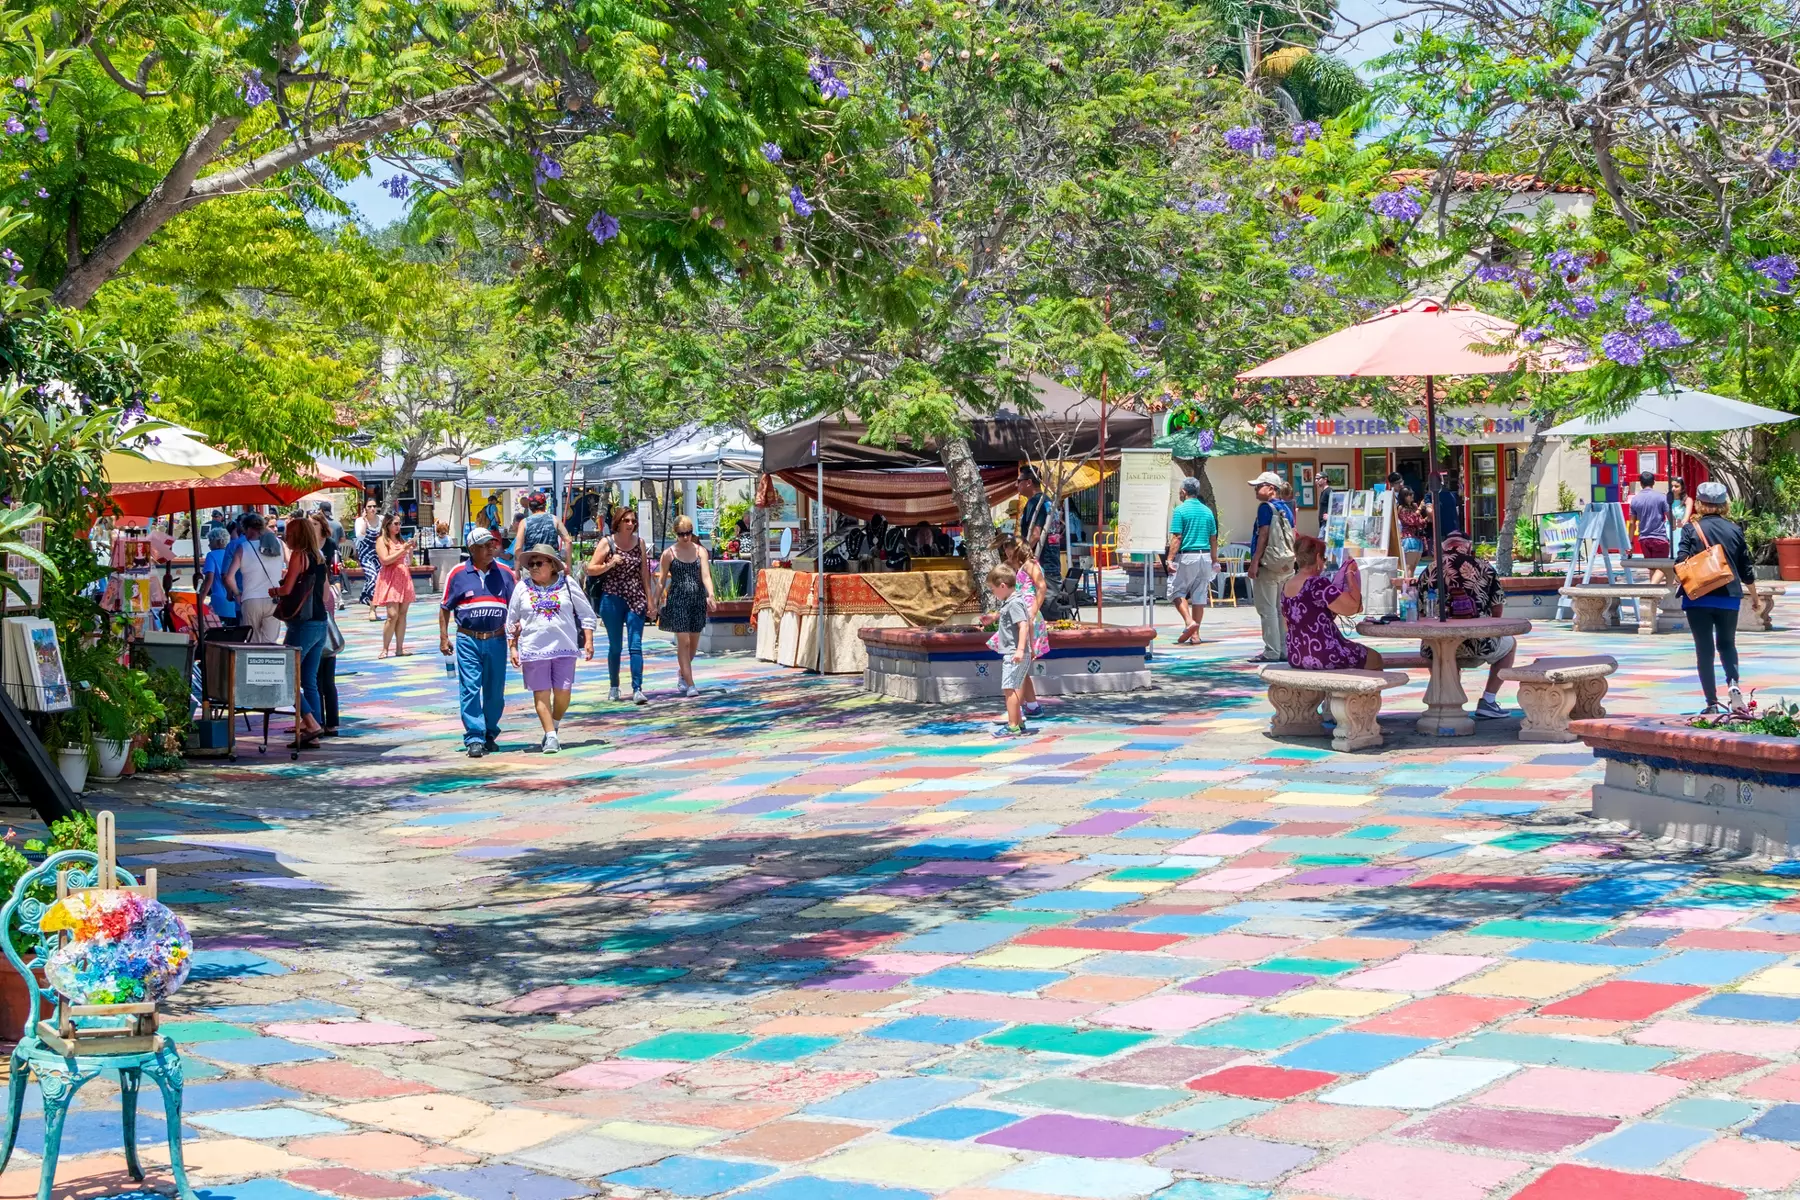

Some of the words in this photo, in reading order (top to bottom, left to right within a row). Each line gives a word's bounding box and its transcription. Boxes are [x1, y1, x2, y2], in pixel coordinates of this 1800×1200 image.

[1408, 417, 1475, 434] ARISTS
[1483, 417, 1525, 434] ASSN
[1126, 472, 1141, 480] JANE
[1142, 472, 1166, 480] TIPTON
[470, 608, 503, 618] NAUTICA
